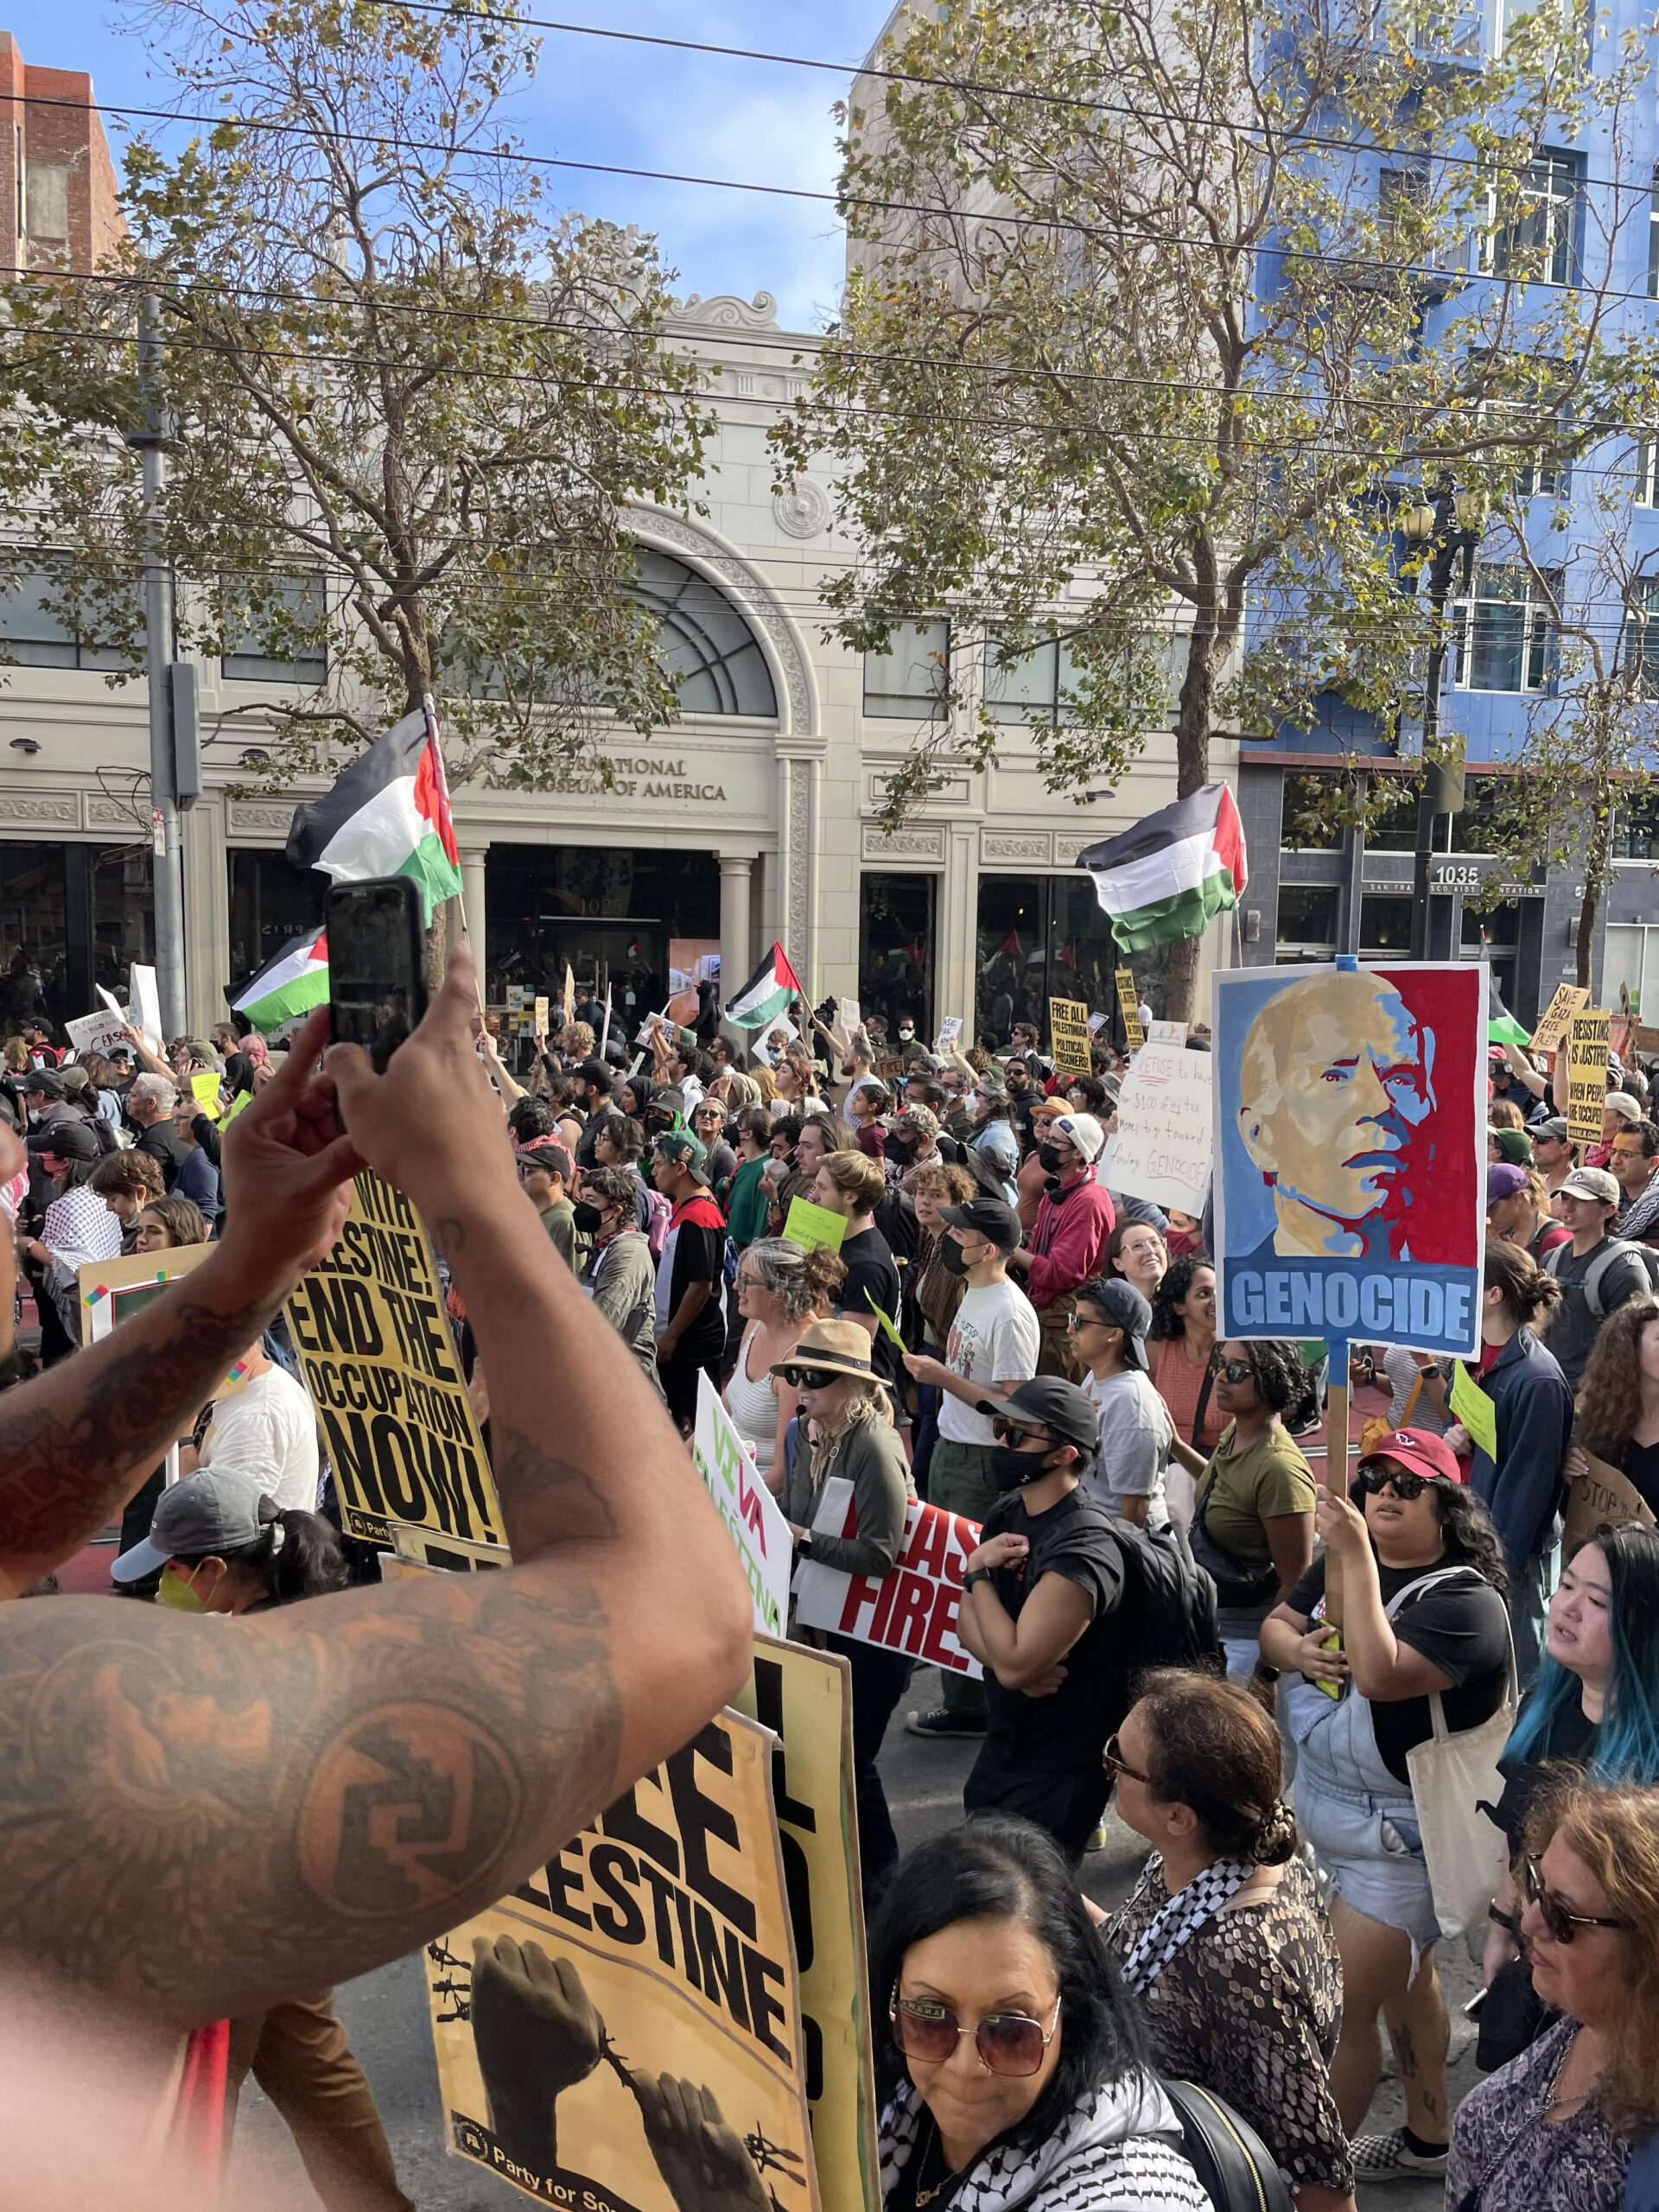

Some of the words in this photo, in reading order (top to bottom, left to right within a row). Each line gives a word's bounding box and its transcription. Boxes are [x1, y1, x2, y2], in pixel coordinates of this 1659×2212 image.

[613, 779, 638, 796] OF
[642, 781, 727, 802] AMERICA
[1436, 866, 1479, 884] 1035
[1370, 883, 1389, 892] SAN
[1554, 987, 1580, 1006] SAVE
[1052, 1001, 1070, 1020] FREE
[1071, 1007, 1086, 1024] ALL
[1550, 1006, 1571, 1020] GAZA
[1540, 1020, 1560, 1032] FREE
[1056, 1038, 1085, 1055] POLITICAL
[1572, 1044, 1580, 1065] IS
[1139, 1056, 1174, 1077] REFUSE
[1179, 1059, 1189, 1079] to
[1134, 1092, 1157, 1111] $100
[1184, 1095, 1201, 1113] tax
[1143, 1119, 1152, 1134] to
[1166, 1120, 1205, 1145] toward
[1231, 1270, 1471, 1343] GENOCIDE
[288, 1276, 384, 1356] END
[380, 1289, 457, 1383] THE
[304, 1357, 474, 1448] OCCUPATION
[320, 1408, 499, 1547] NOW!
[1582, 1476, 1618, 1516] STOP
[493, 2145, 541, 2191] Party
[545, 2177, 577, 2203] for
[582, 2190, 619, 2212] So
